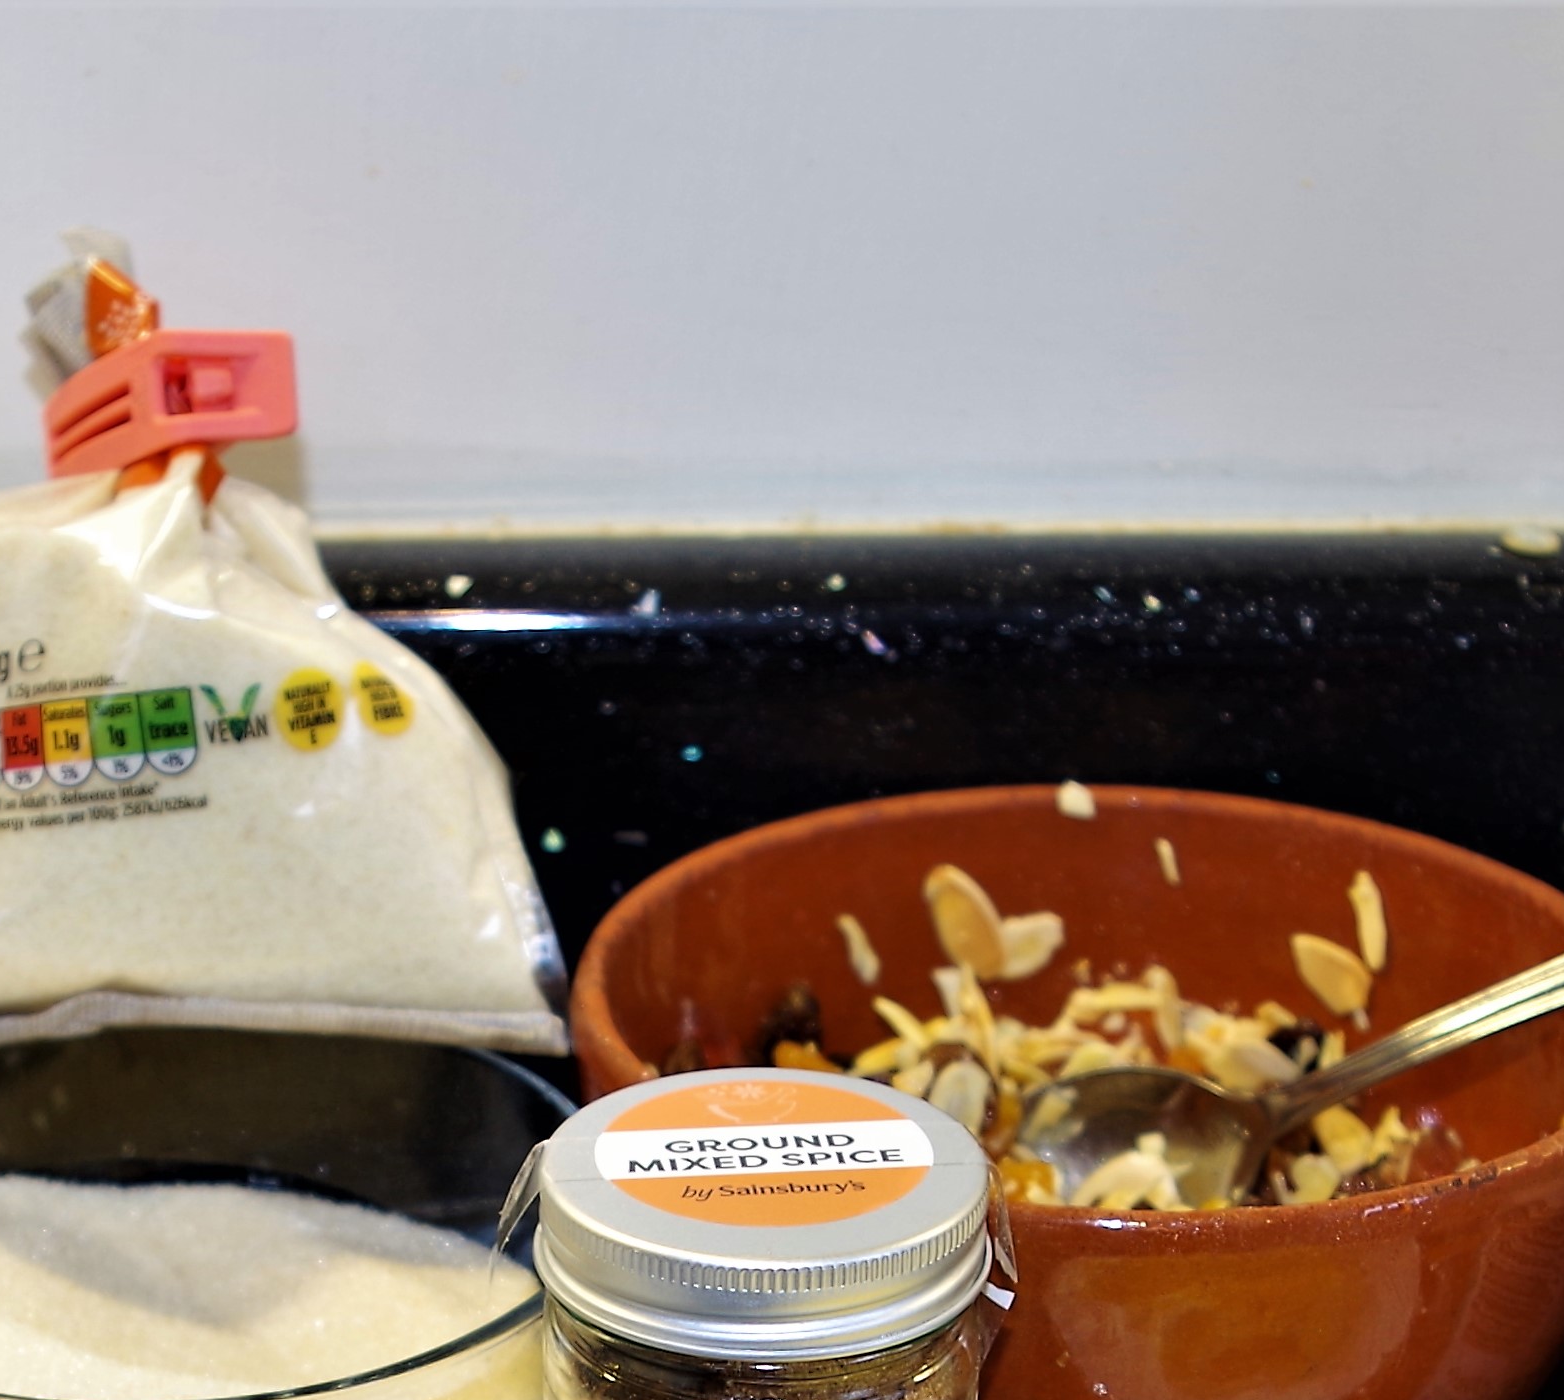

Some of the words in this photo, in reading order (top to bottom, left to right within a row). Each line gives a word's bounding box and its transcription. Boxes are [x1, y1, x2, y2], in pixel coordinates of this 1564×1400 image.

[204, 714, 270, 744] VEAN
[664, 1133, 855, 1154] GROUND
[628, 1154, 768, 1173] MIXED
[782, 1148, 904, 1167] SPICE
[680, 1183, 715, 1201] by
[719, 1179, 866, 1197] Sainsbury's
